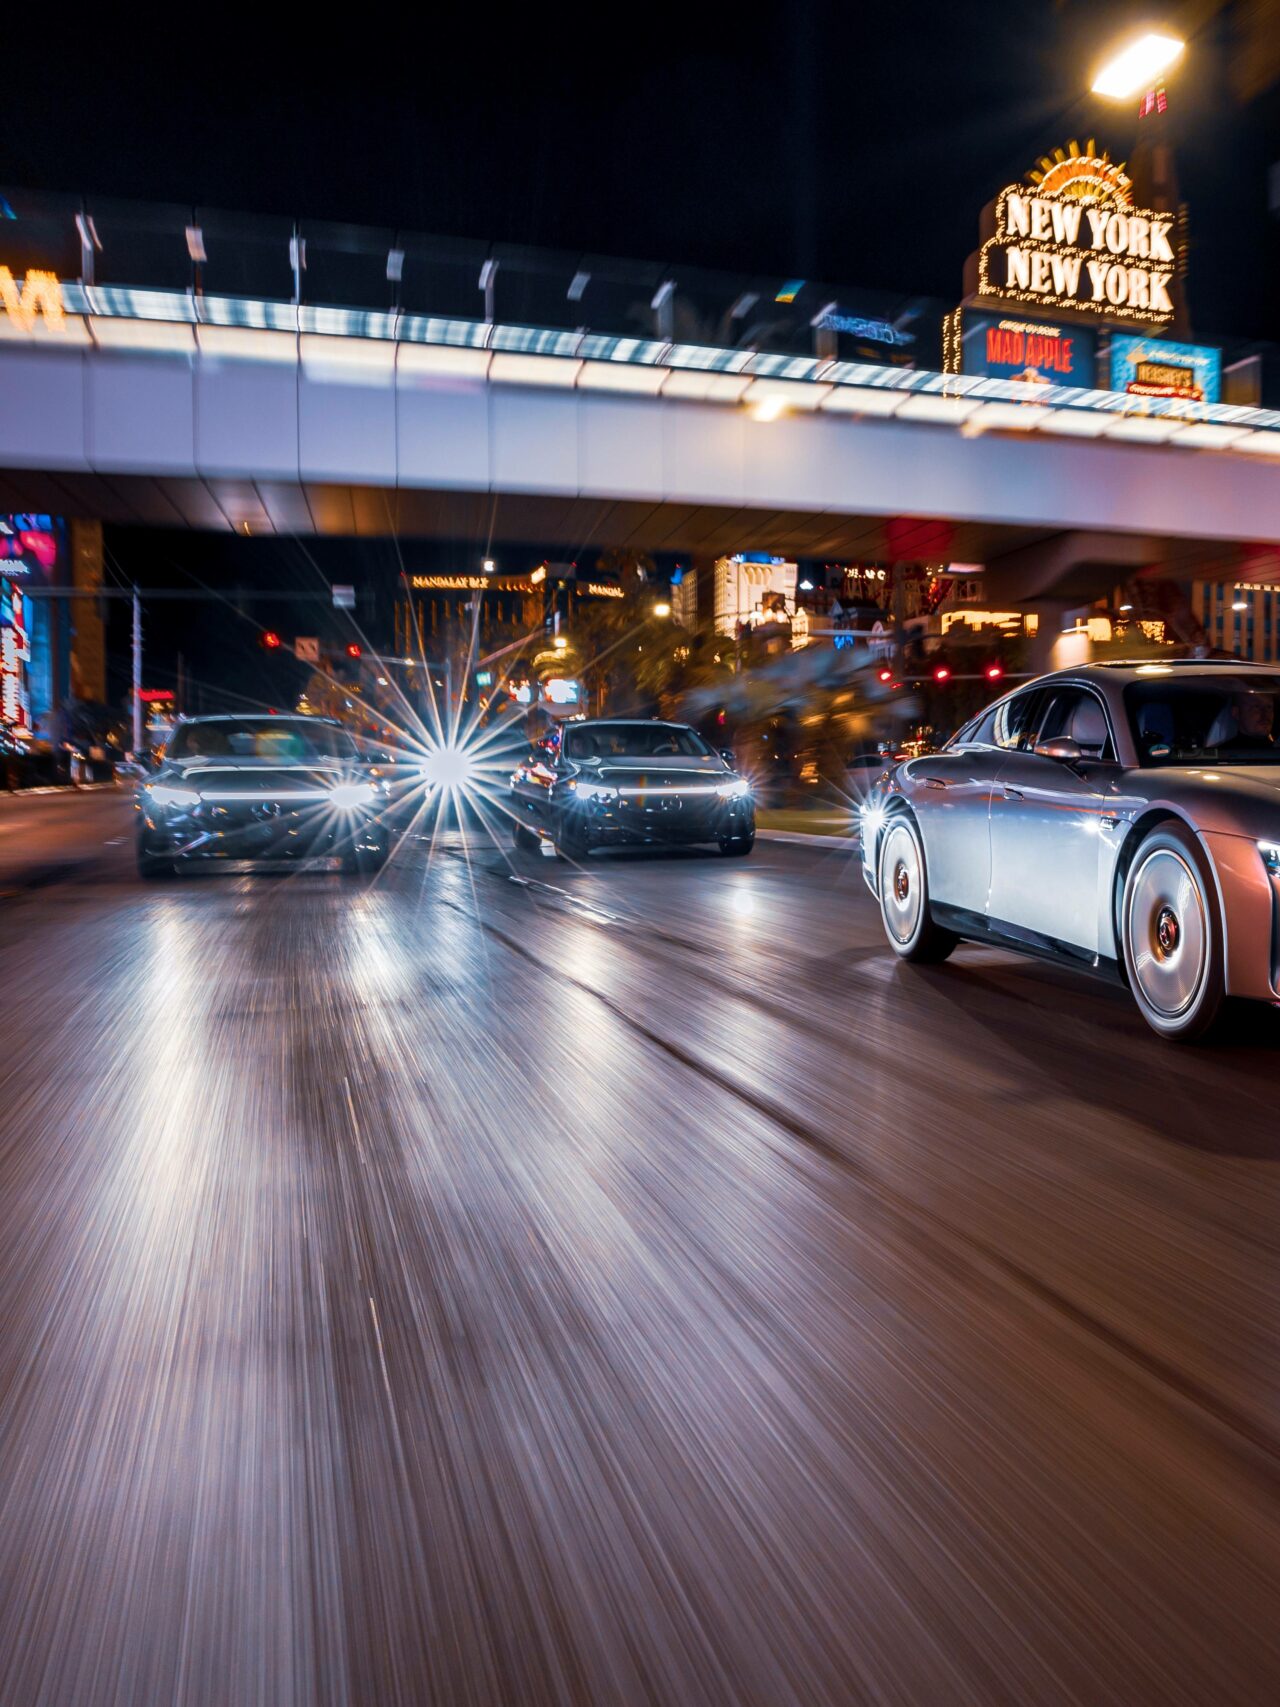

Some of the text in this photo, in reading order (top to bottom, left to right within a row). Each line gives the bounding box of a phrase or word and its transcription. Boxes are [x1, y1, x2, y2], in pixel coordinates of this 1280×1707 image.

[1005, 193, 1175, 262] NEW YORK
[1005, 246, 1175, 312] NEW YORK
[987, 327, 1073, 373] MAD APPLE
